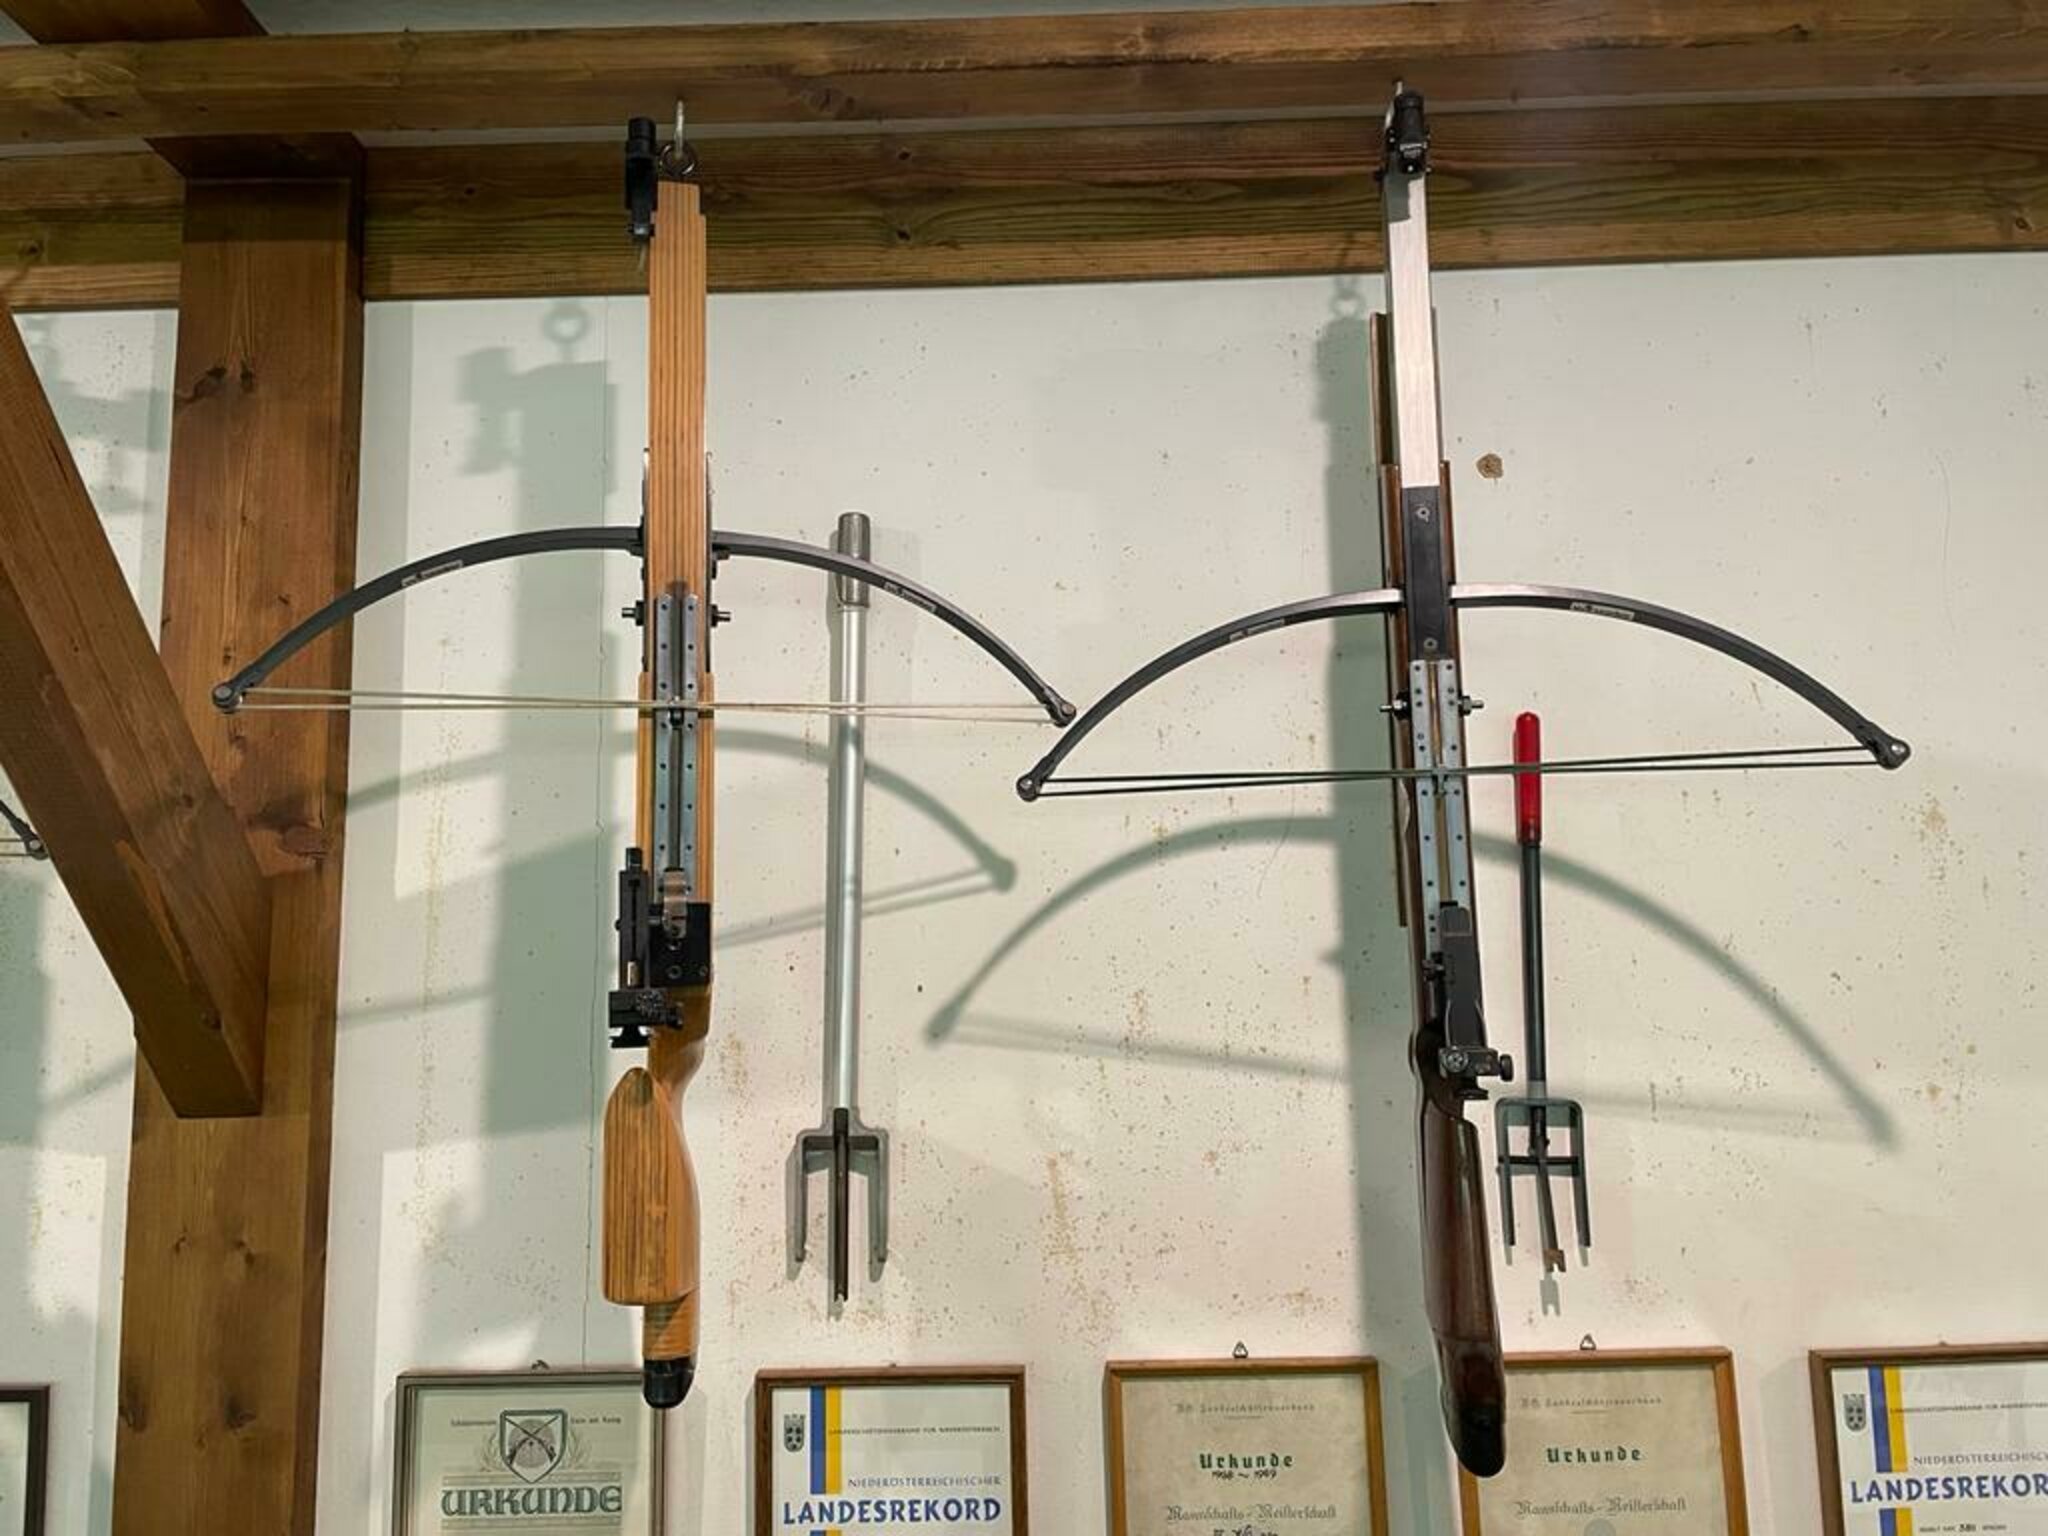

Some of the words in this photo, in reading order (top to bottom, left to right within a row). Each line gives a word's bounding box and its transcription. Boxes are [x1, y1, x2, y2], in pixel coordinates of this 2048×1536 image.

[1199, 1453, 1293, 1469] Urkunde
[1547, 1447, 1642, 1463] Urkunde
[441, 1485, 622, 1516] URKUNDE
[784, 1498, 1001, 1525] LANDESREKORD
